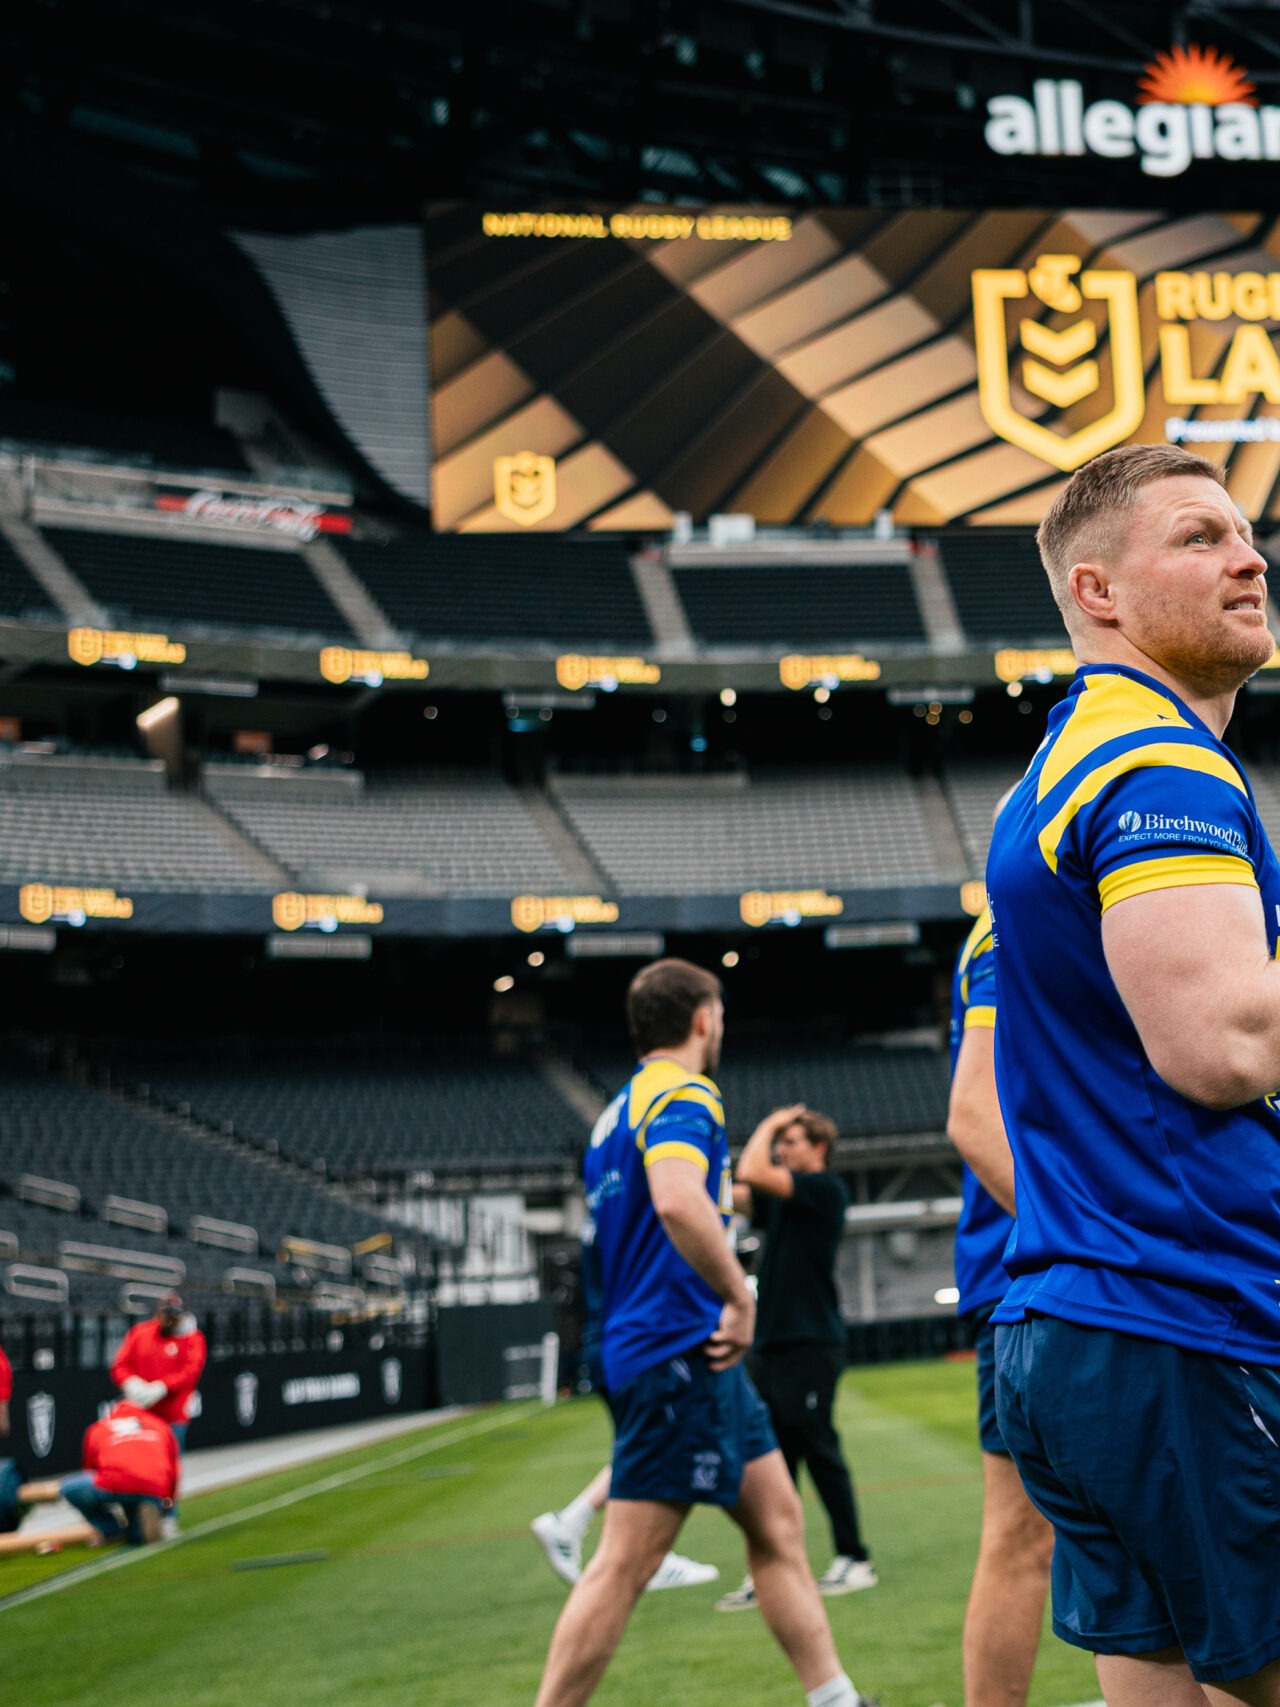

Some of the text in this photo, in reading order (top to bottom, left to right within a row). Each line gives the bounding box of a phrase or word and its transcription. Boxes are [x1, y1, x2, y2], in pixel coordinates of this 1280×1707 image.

[1118, 832, 1152, 843] EXPECT
[1154, 832, 1181, 841] MORE
[1183, 834, 1208, 845] FROM
